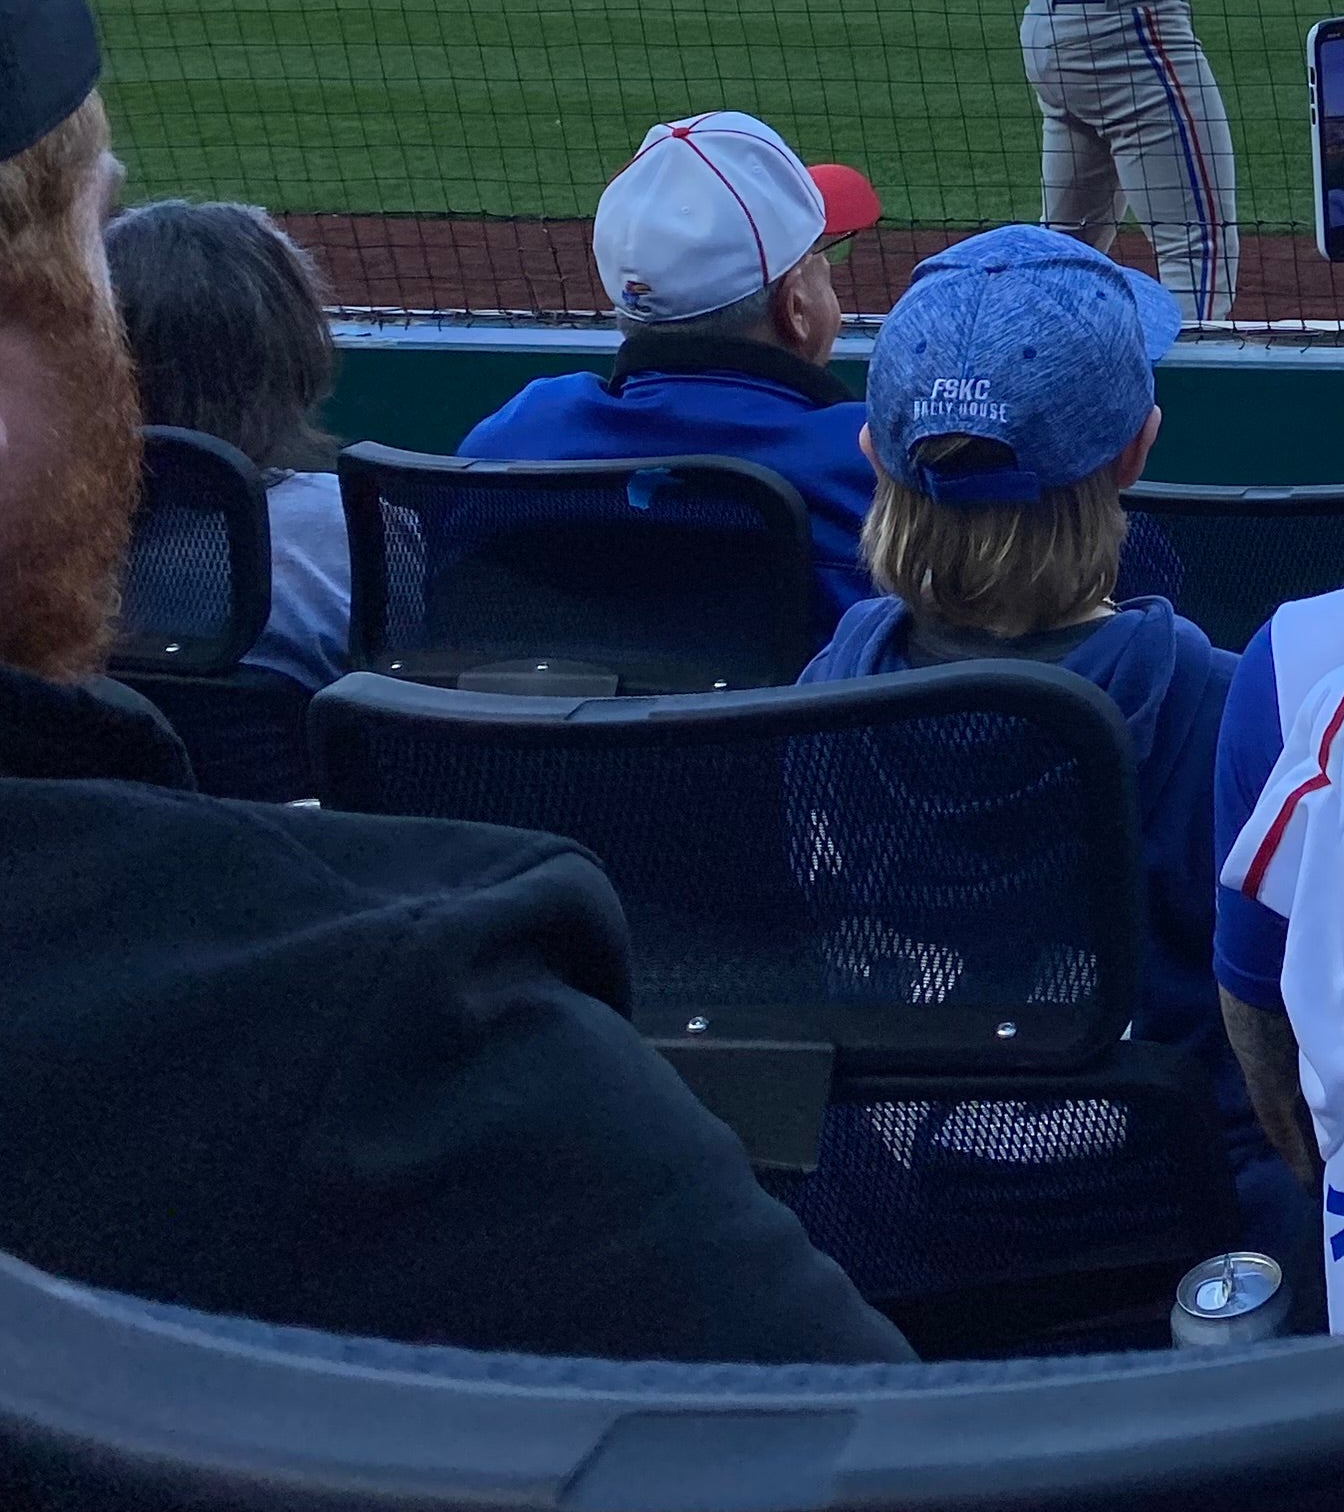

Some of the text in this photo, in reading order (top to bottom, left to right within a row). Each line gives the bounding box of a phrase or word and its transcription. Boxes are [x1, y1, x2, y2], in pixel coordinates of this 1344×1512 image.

[930, 378, 991, 402] FSKC
[913, 399, 1009, 423] RALLY HOUSE
